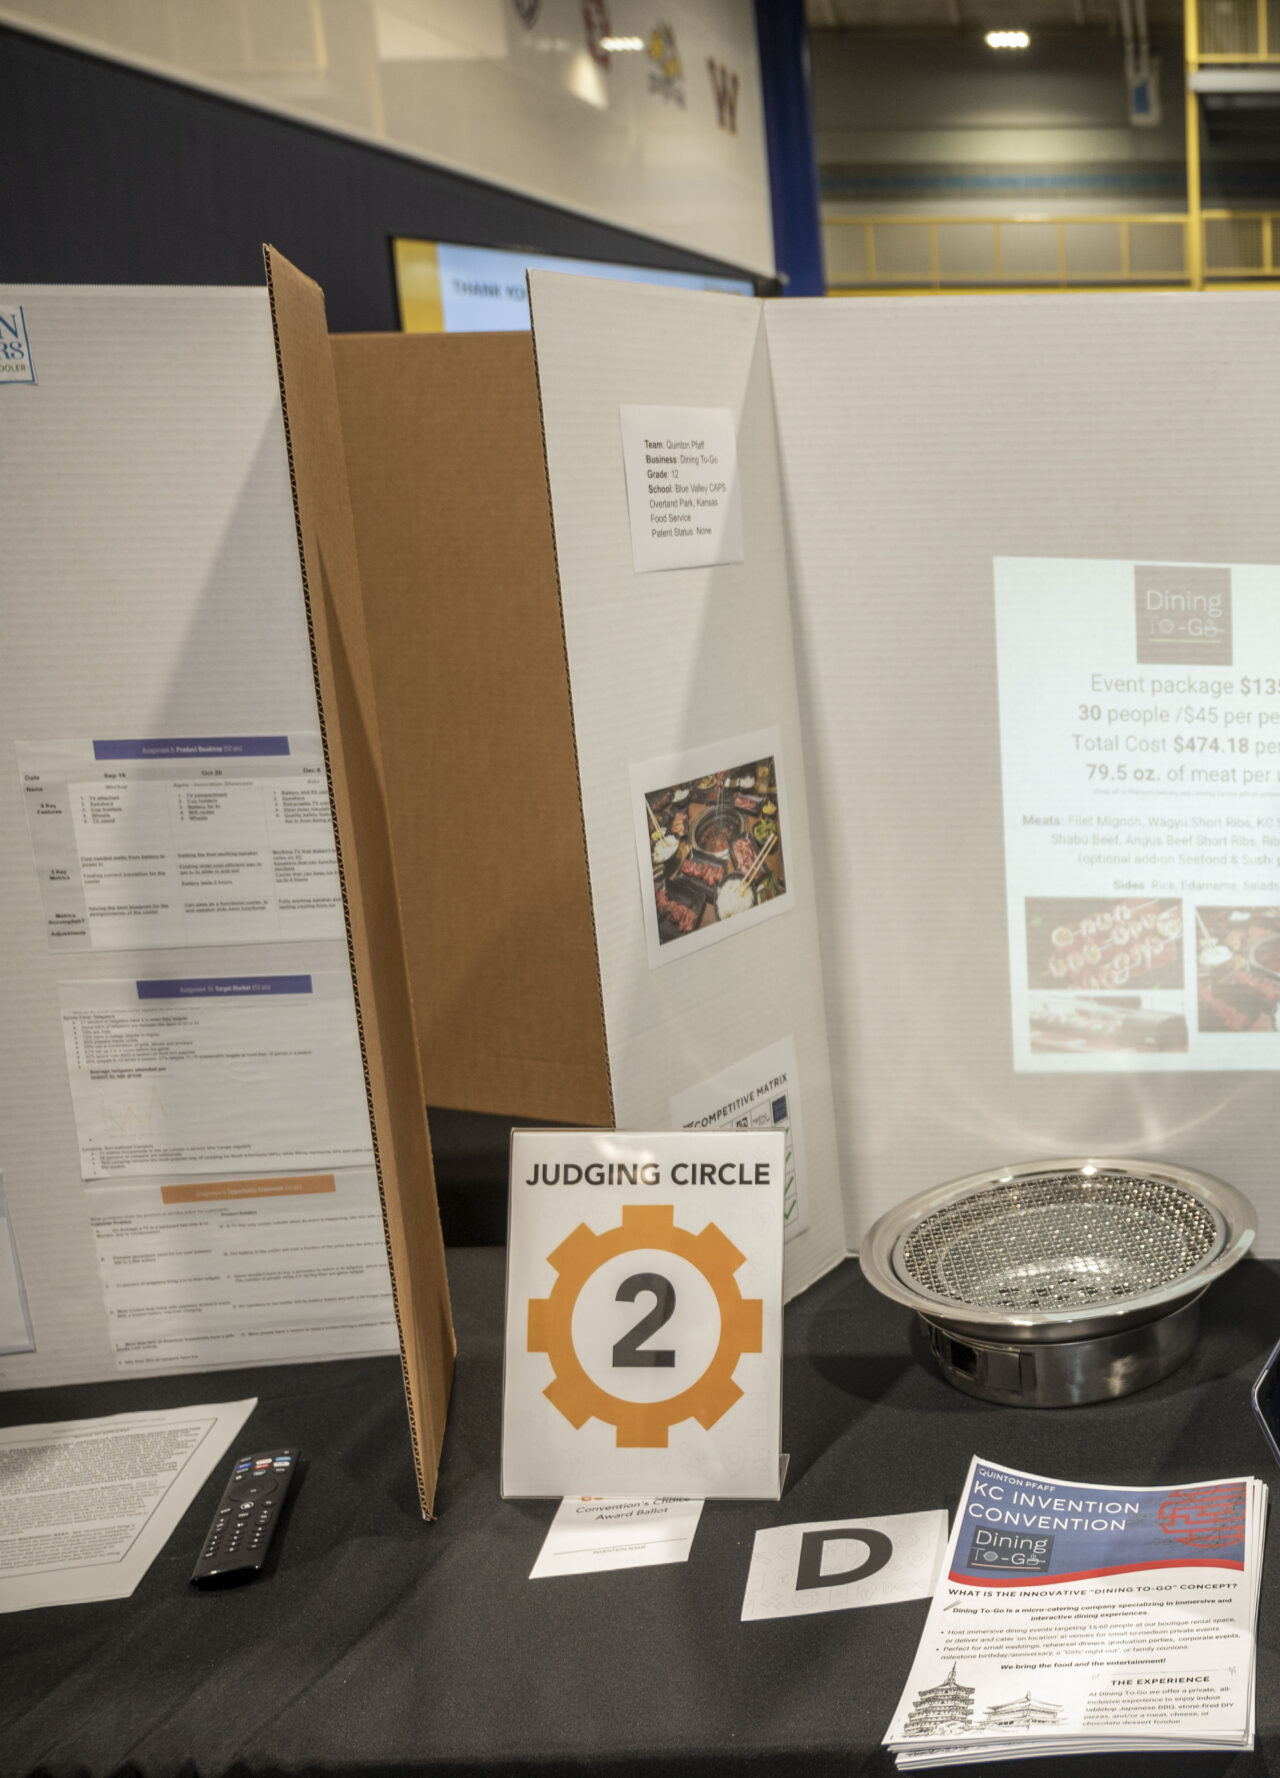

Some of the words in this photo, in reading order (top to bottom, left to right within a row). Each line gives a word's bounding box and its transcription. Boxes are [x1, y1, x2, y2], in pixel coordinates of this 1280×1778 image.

[452, 279, 502, 298] THANK
[666, 440, 690, 450] Quinton
[692, 440, 705, 449] Pfaff
[680, 455, 699, 466] Dining
[701, 454, 718, 464] To-Go
[647, 469, 669, 479] Grade:
[672, 469, 679, 479] 12
[676, 484, 689, 493] Blue
[691, 483, 708, 494] Valley
[709, 483, 726, 493] CAPS
[650, 499, 678, 509] Overland
[679, 498, 695, 508] Park,
[696, 498, 718, 507] Kansas
[651, 514, 667, 523] Food
[668, 513, 691, 522] Service
[652, 528, 672, 537] Patent
[696, 527, 712, 536] None
[1146, 589, 1222, 618] Dining
[1091, 673, 1145, 693] Event
[1151, 675, 1234, 699] package
[1078, 704, 1101, 721] 30
[1107, 705, 1170, 726] people
[1175, 704, 1219, 724] /$45
[1224, 711, 1253, 728] per
[1072, 734, 1119, 752] Total
[1125, 735, 1167, 753] Cost
[1174, 734, 1249, 754] $474.18
[1086, 763, 1127, 781] 79.5
[1133, 769, 1161, 782] oz.
[1167, 764, 1186, 782] of
[1191, 767, 1237, 783] meat
[1243, 770, 1271, 786] per
[1022, 815, 1063, 827] Meats:
[1067, 815, 1094, 827] Filet
[1148, 816, 1188, 830] Wagyu
[1191, 816, 1222, 828] Short
[1257, 817, 1274, 829] KC
[1051, 833, 1089, 845] Shabu
[1125, 835, 1163, 848] Angus
[1167, 835, 1193, 846] Beef
[1196, 835, 1228, 847] Short
[1078, 853, 1131, 866] (optional
[1134, 854, 1175, 865] add-on
[1178, 854, 1227, 865] Seafood
[1242, 854, 1274, 866] Sushi
[694, 1091, 755, 1128] COMPETITIVE
[756, 1073, 788, 1098] MATRIX
[526, 1162, 661, 1186] JUDGING
[670, 1162, 771, 1186] CIRCLE
[612, 1272, 677, 1368] 2
[979, 1467, 1023, 1487] QUINTON
[1025, 1482, 1057, 1492] PFAFF
[973, 1480, 1005, 1500] KC
[1012, 1491, 1140, 1514] INVENTION
[576, 1500, 650, 1514] Convention's
[595, 1511, 633, 1521] Award
[636, 1507, 668, 1516] Ballot
[968, 1503, 1126, 1531] CONVENTION
[975, 1529, 1049, 1554] Dining
[795, 1528, 894, 1592] D
[948, 1588, 979, 1597] WHAT
[996, 1590, 1016, 1598] THE
[1019, 1589, 1087, 1597] INNOVATIVE
[952, 1607, 978, 1615] Dining
[1021, 1605, 1079, 1613] micro-catering
[1081, 1603, 1116, 1611] company
[1118, 1600, 1164, 1609] specializing
[1074, 1612, 1099, 1620] dining
[1015, 1662, 1037, 1670] bring
[1106, 1658, 1166, 1666] entertainment!
[1136, 1676, 1211, 1685] EXPERIENCE
